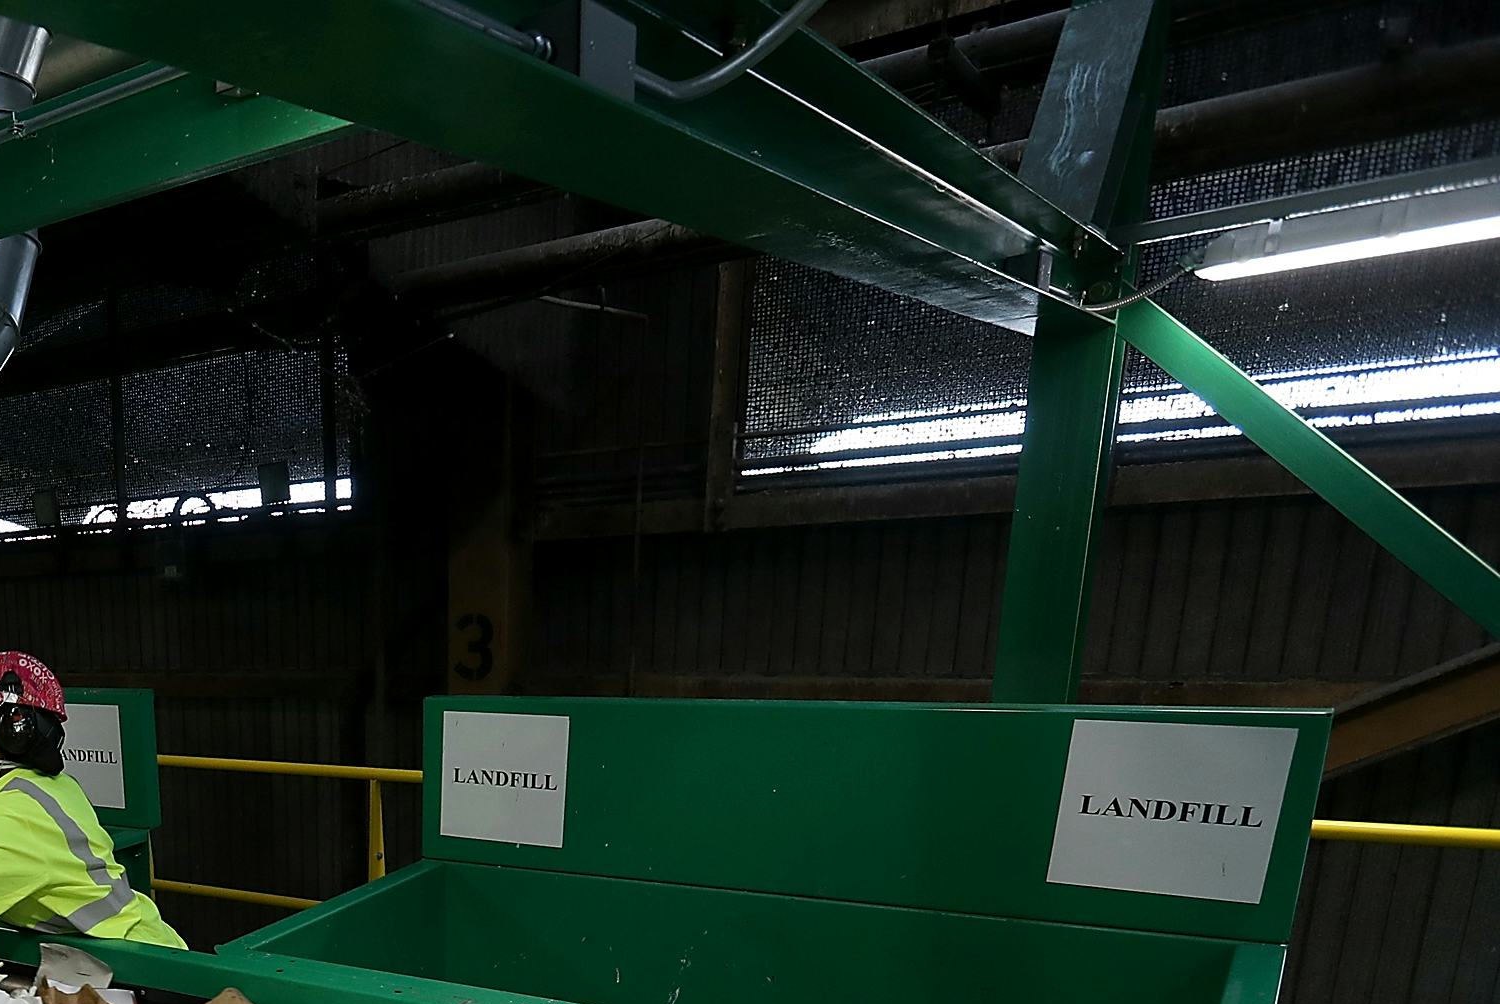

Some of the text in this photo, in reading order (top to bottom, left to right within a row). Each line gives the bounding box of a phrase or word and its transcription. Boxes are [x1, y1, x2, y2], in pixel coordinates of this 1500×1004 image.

[453, 613, 493, 681] 3
[60, 750, 118, 764] ANDFILL
[453, 767, 558, 791] LANDFILL
[1078, 795, 1263, 828] LANDFILL
